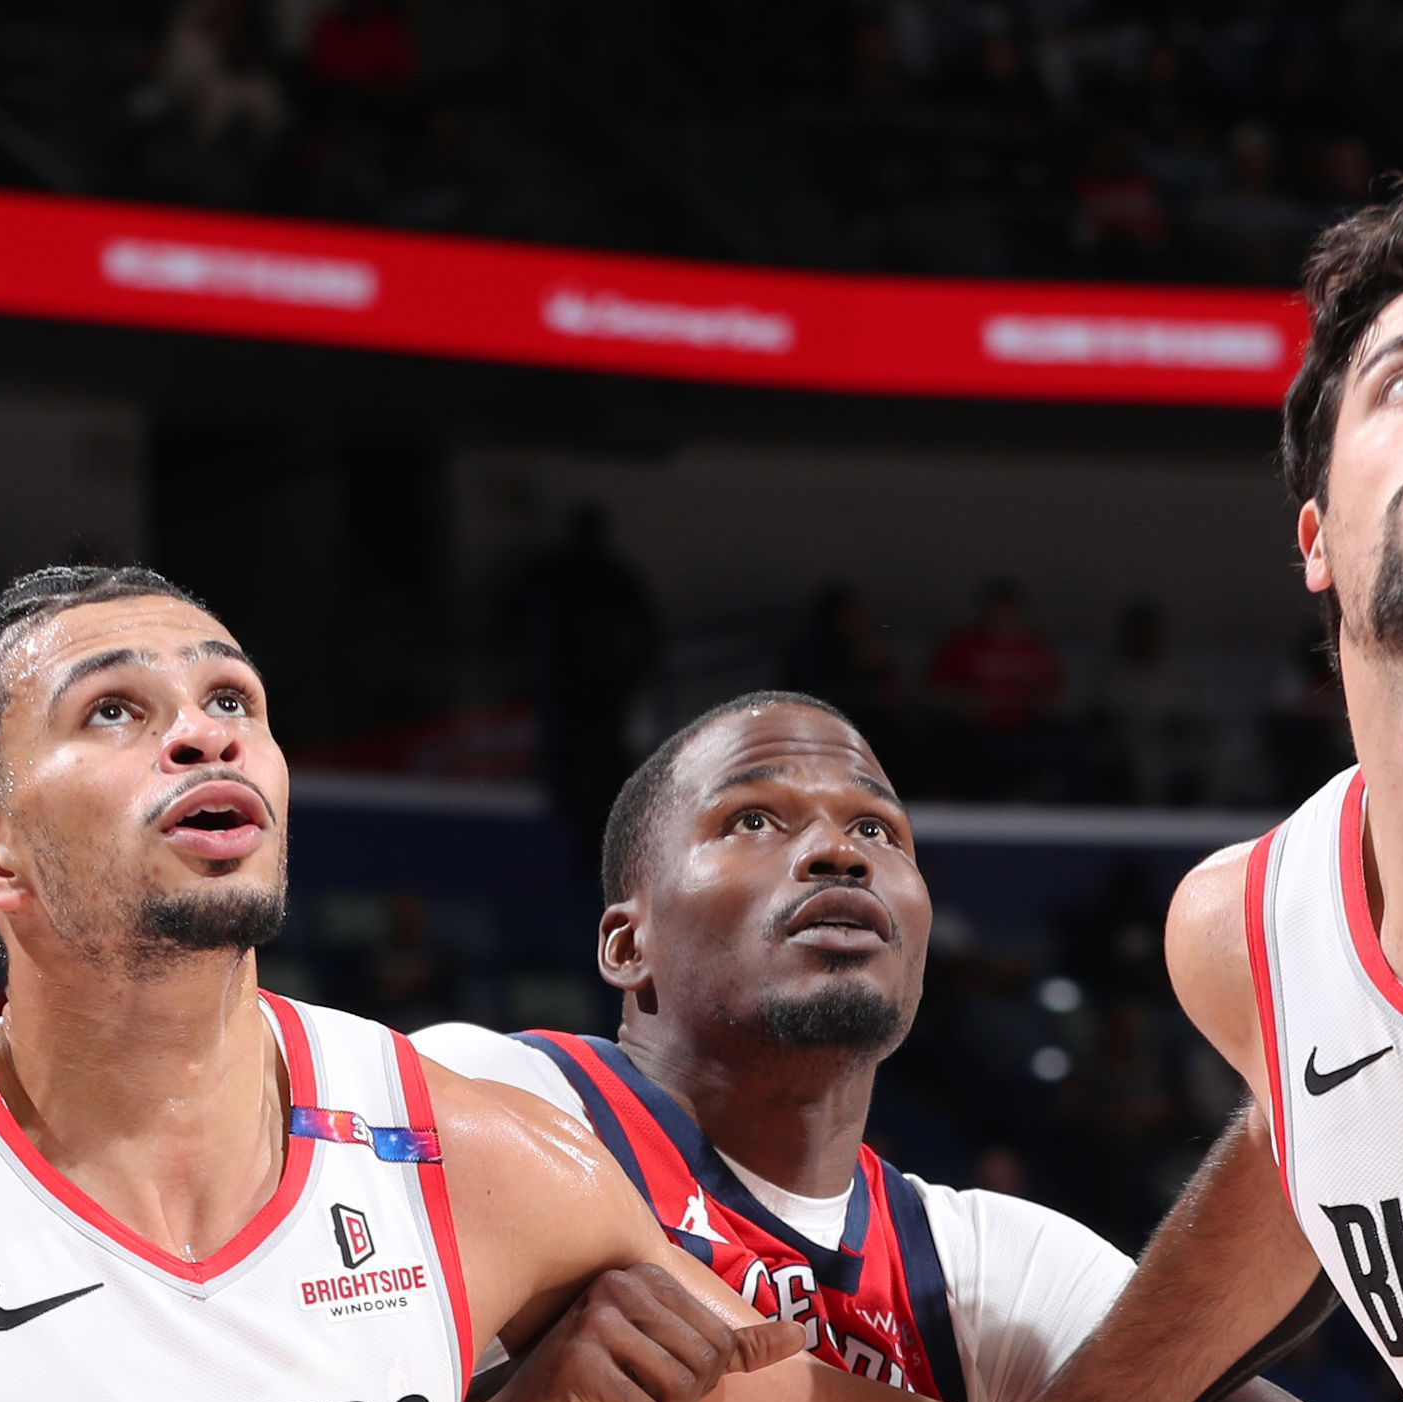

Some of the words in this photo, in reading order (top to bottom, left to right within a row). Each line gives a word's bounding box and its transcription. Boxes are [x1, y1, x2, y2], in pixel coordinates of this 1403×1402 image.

[346, 1216, 367, 1255] B
[301, 1265, 427, 1306] BRIGHTSIDE
[330, 1297, 408, 1317] WINDOWS
